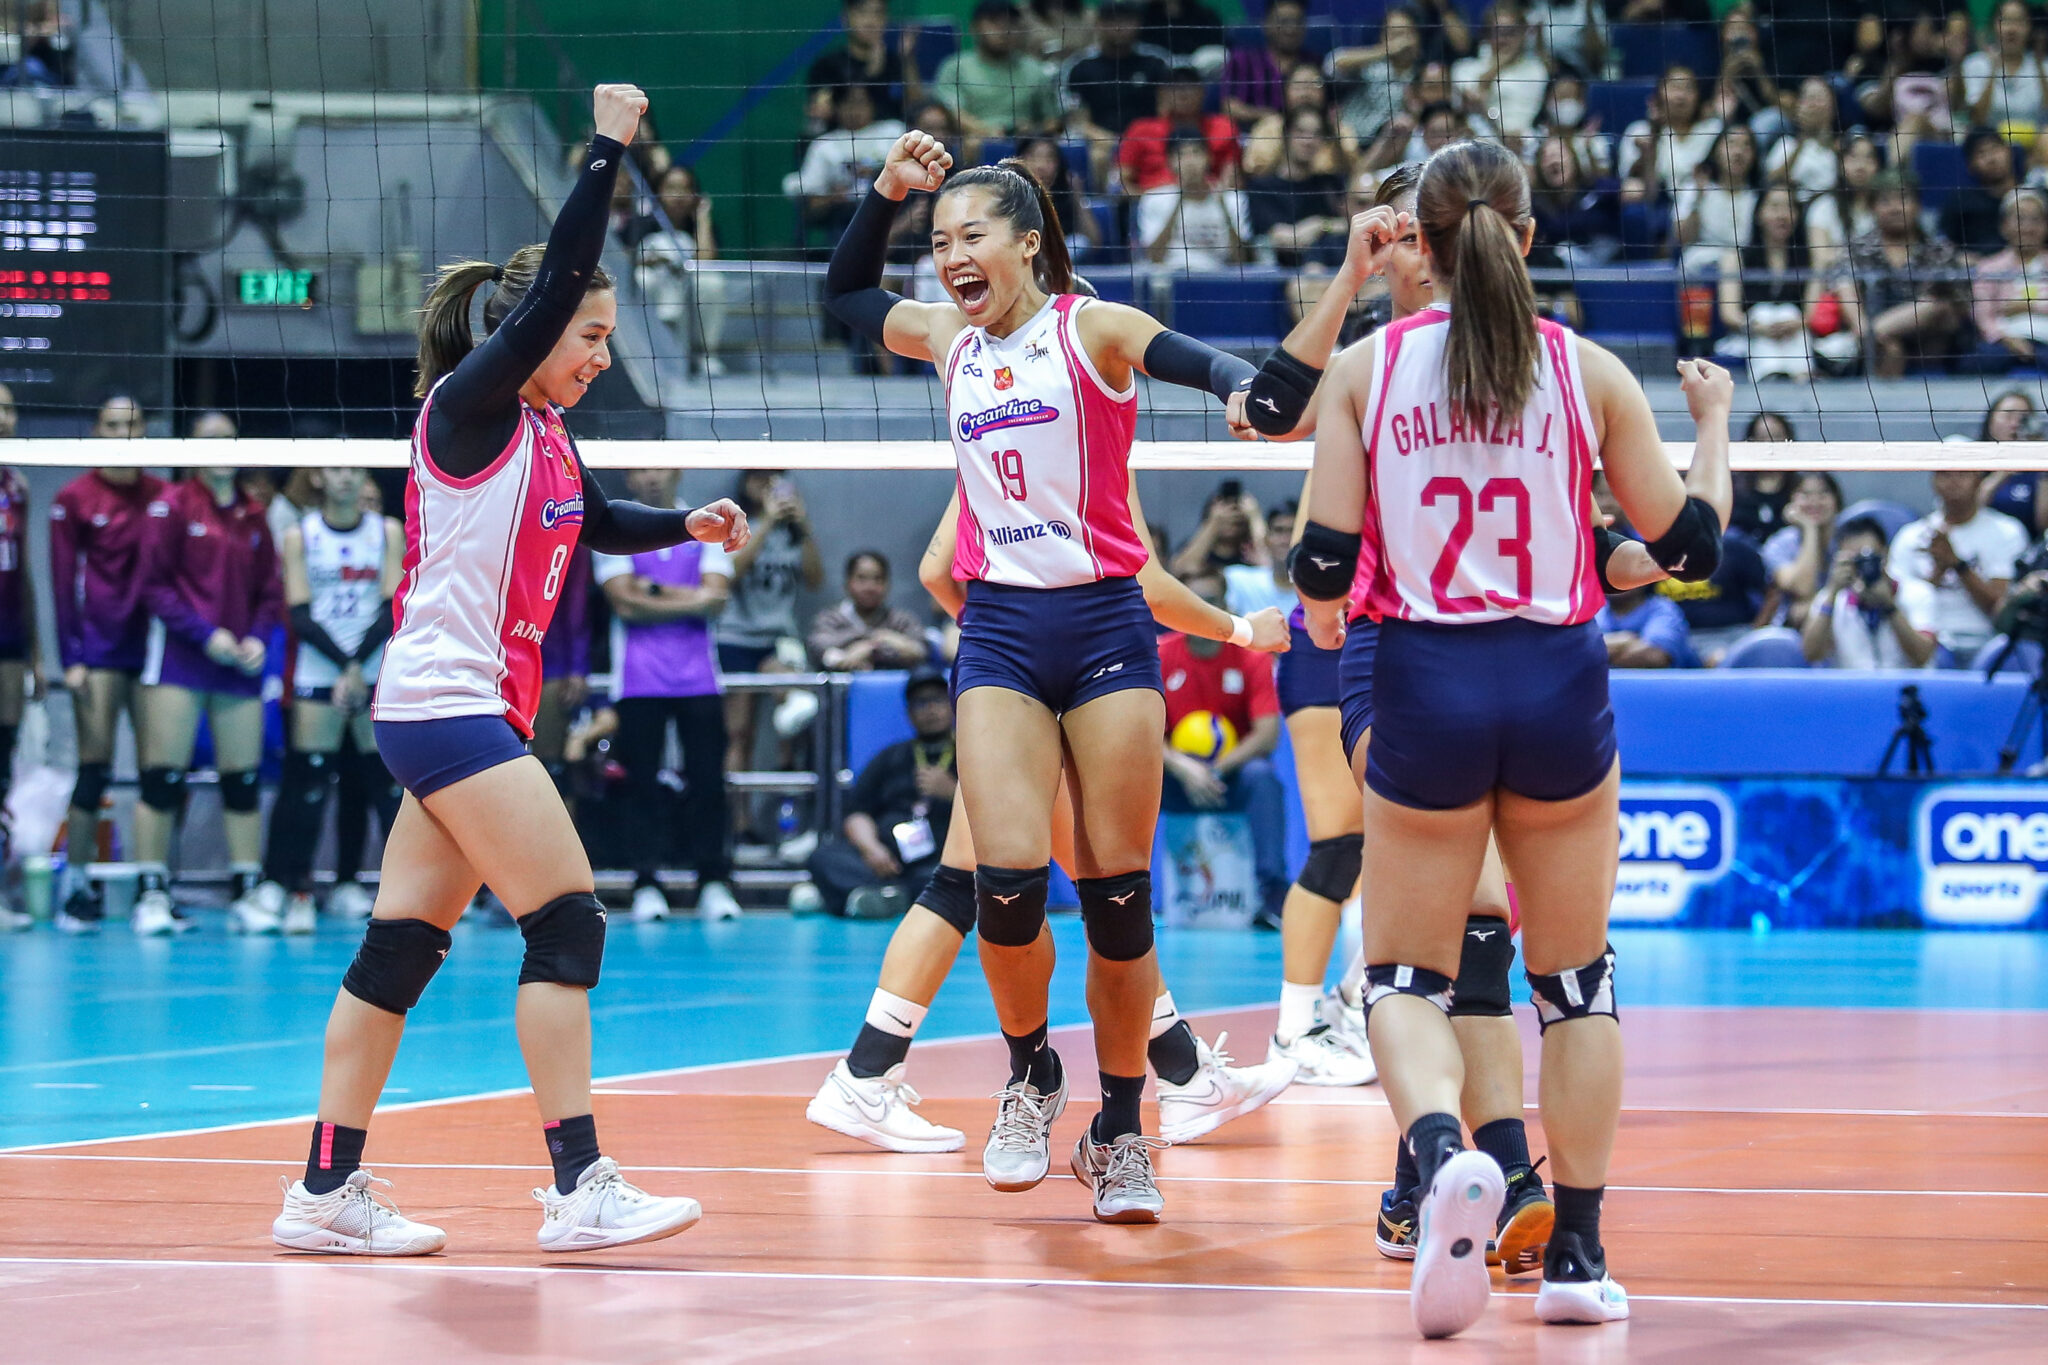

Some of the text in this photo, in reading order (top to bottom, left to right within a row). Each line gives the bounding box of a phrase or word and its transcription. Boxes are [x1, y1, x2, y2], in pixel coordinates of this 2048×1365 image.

[958, 400, 1041, 441] Creamline
[1535, 412, 1554, 459] J.
[992, 449, 1027, 501] 19
[541, 493, 584, 530] Creamlin
[989, 523, 1047, 546] Allianz
[1420, 476, 1533, 613] 23
[543, 544, 568, 601] 8
[1942, 812, 2048, 862] one
